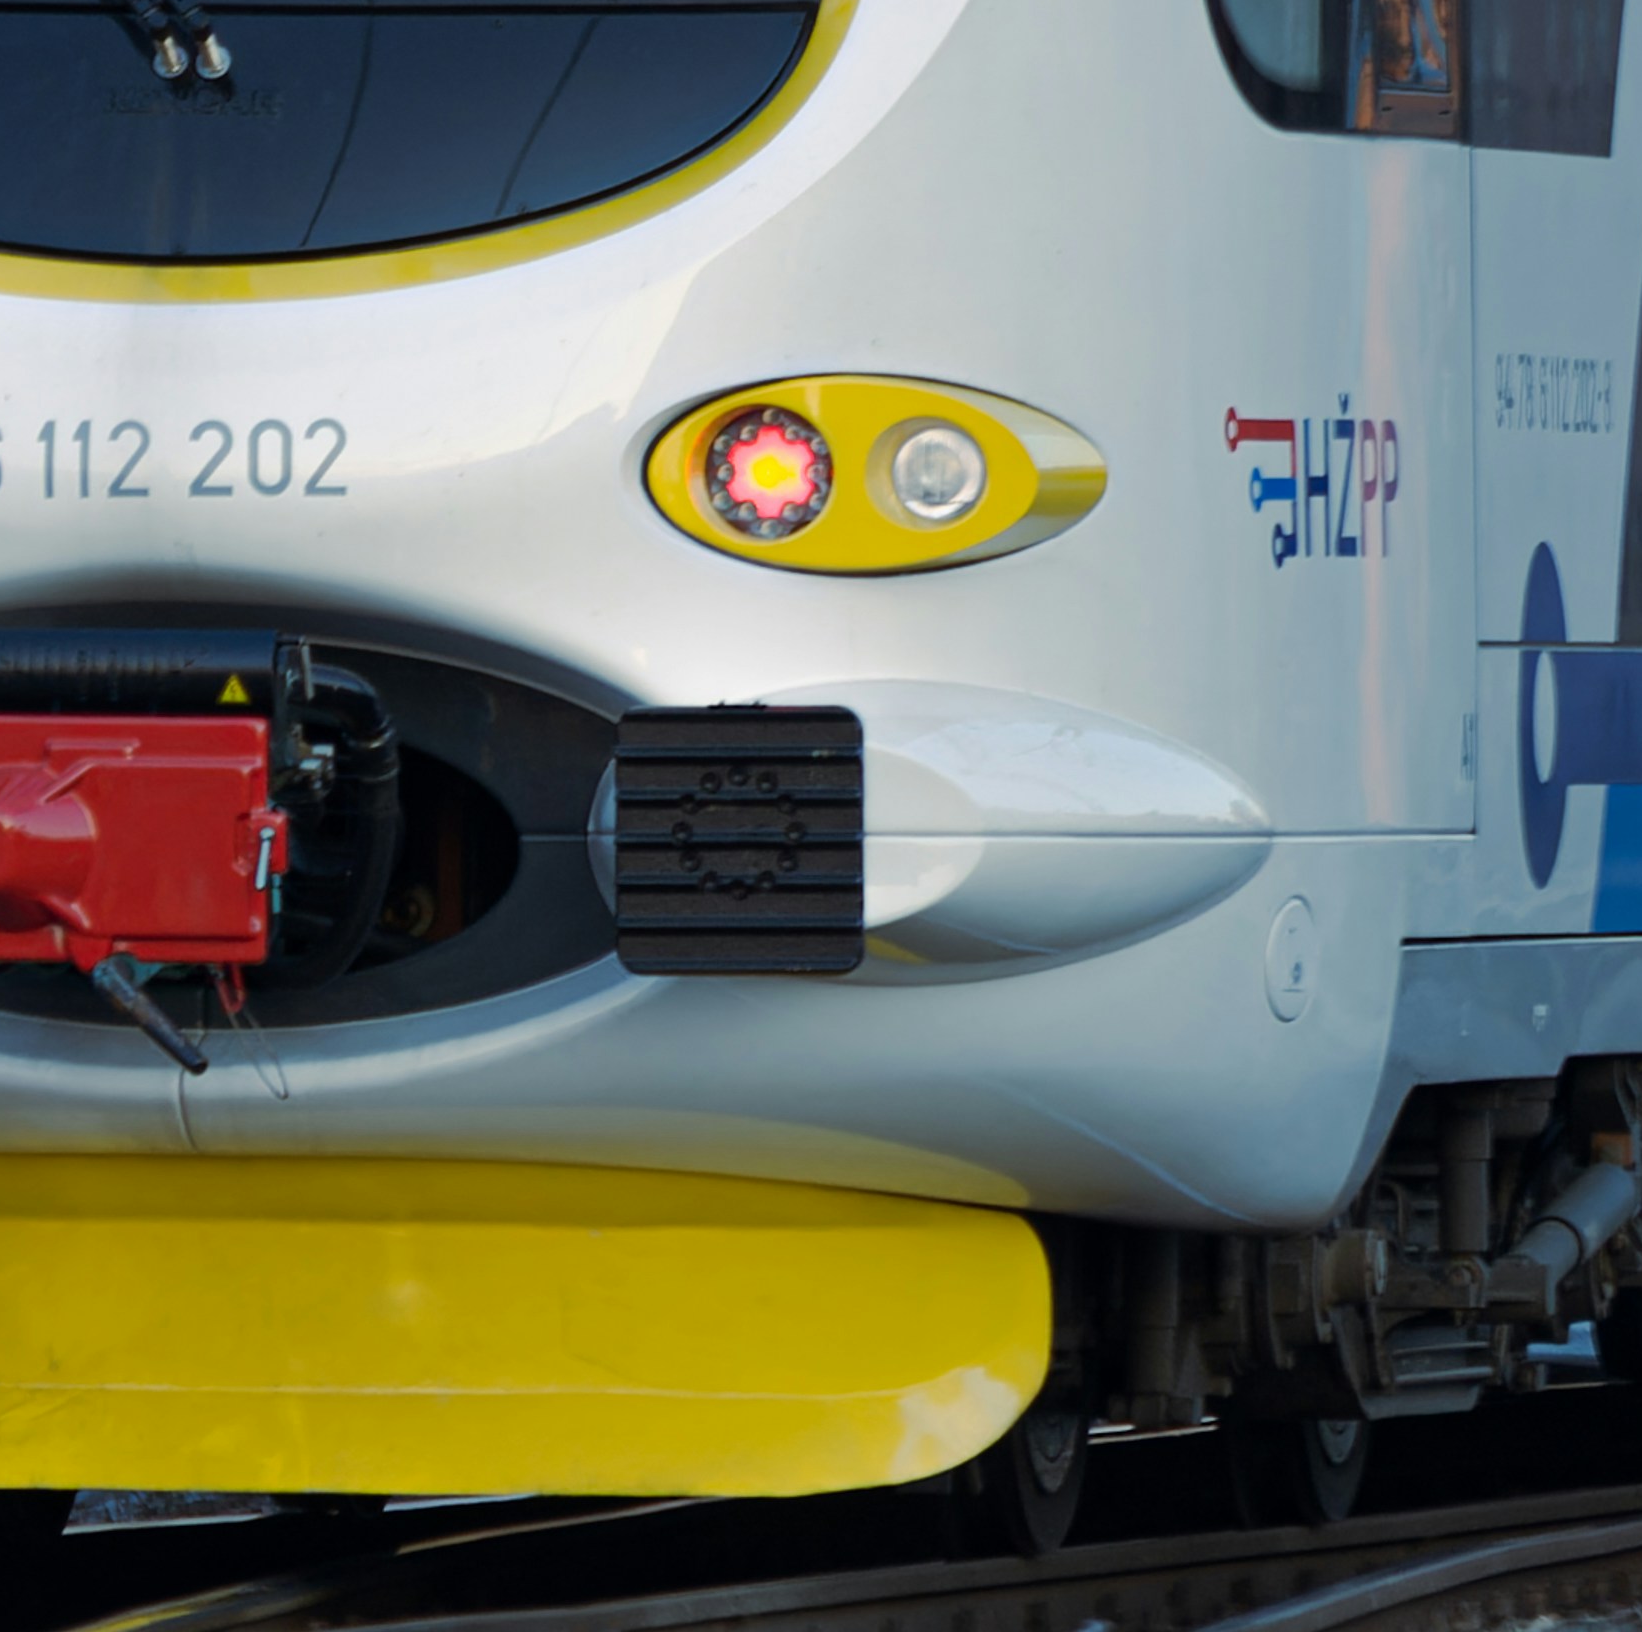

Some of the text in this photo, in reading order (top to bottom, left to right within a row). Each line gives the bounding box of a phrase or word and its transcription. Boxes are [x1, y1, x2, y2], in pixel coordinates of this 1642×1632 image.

[36, 419, 151, 499] 112
[187, 417, 348, 497] 202
[1302, 392, 1401, 558] HŽPP
